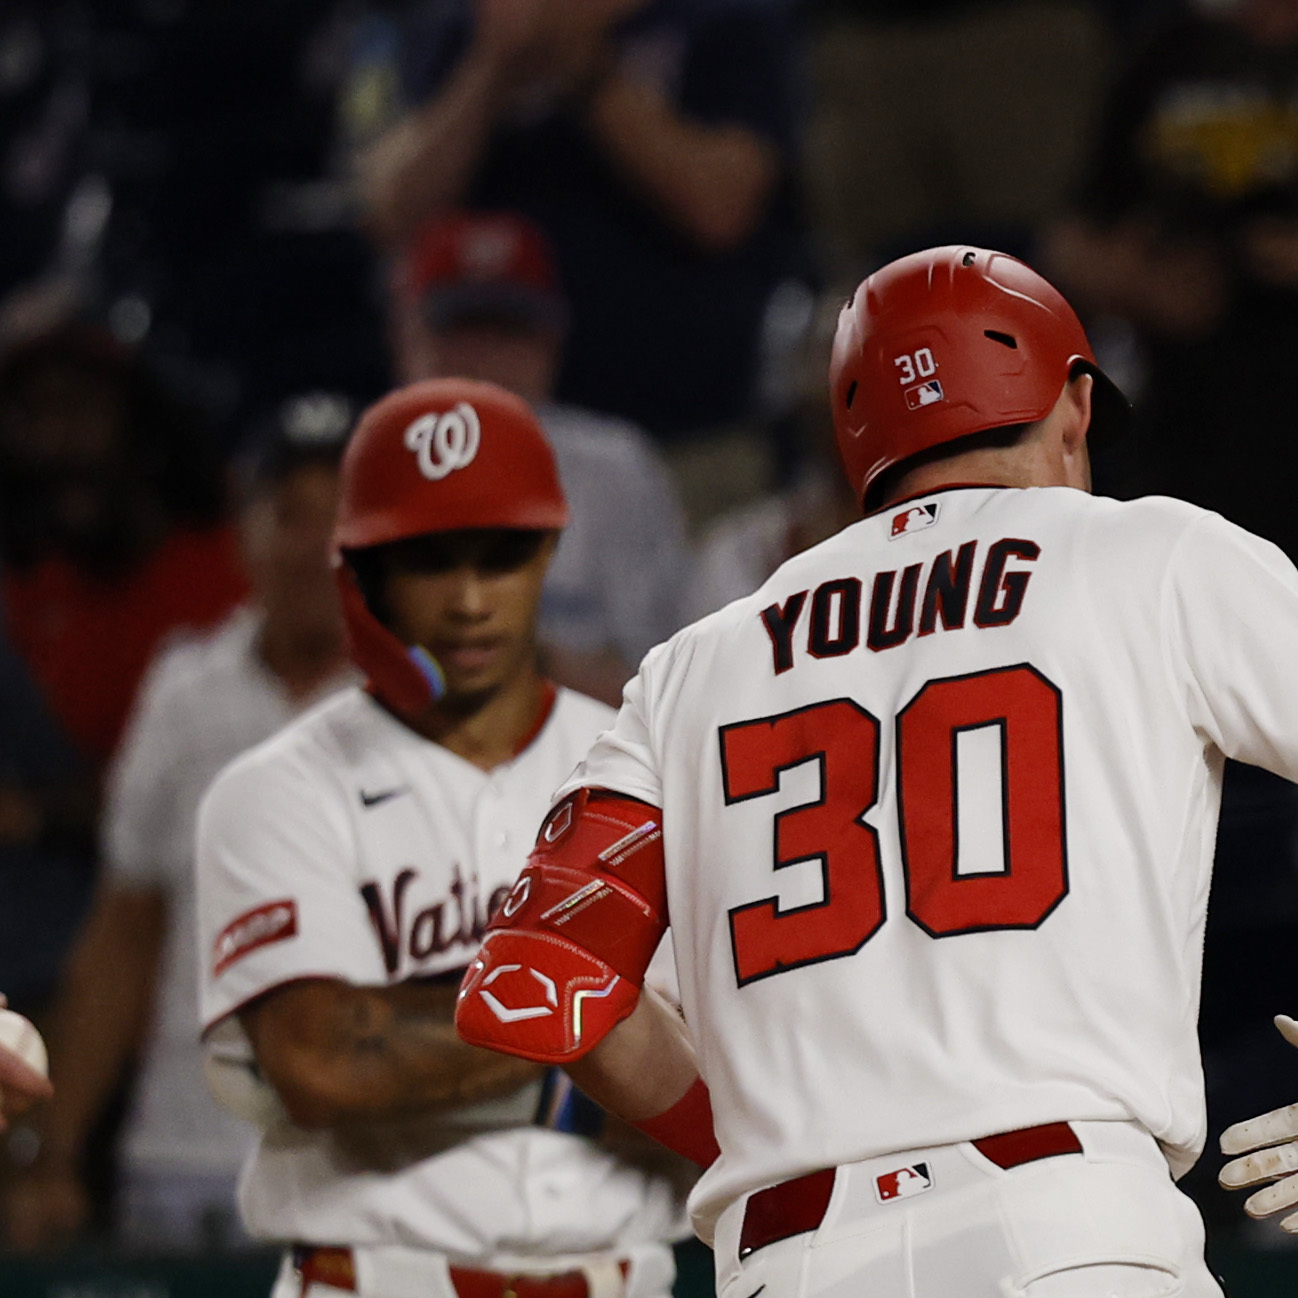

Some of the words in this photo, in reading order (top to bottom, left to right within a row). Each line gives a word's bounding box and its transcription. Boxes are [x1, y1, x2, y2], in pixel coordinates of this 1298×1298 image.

[894, 348, 936, 385] 30
[760, 538, 1042, 676] YOUNG
[718, 661, 1070, 989] 30
